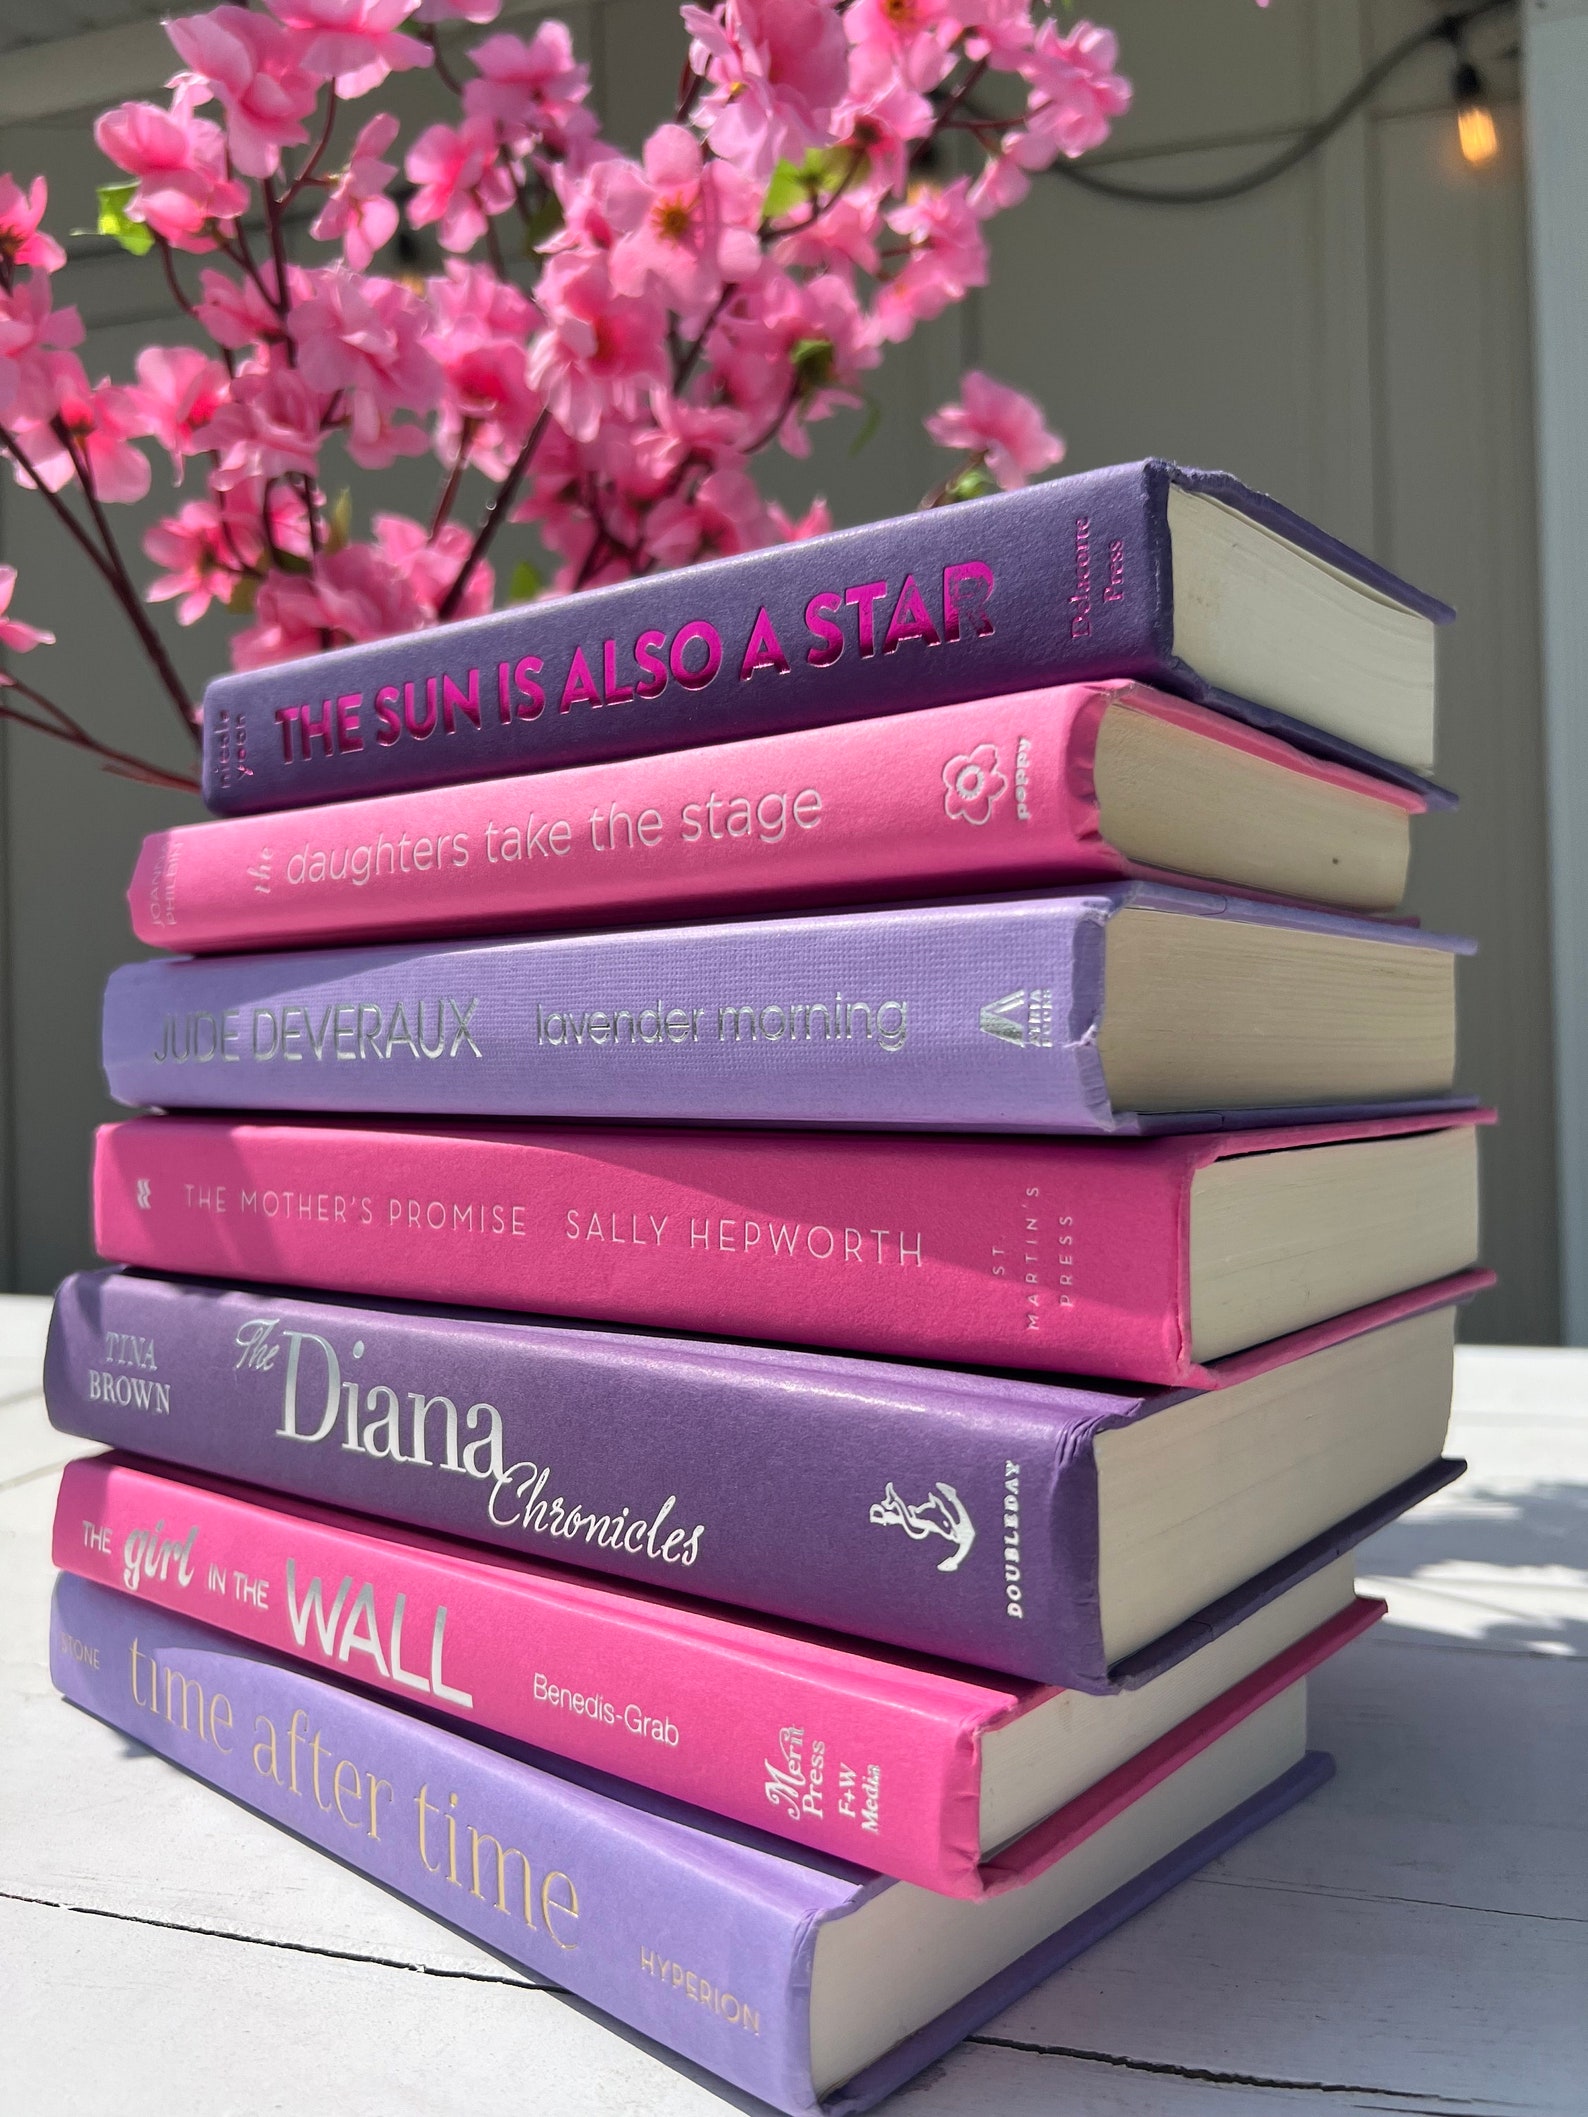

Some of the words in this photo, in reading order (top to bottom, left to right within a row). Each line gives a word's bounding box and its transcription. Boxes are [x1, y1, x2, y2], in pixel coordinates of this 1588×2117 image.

[1069, 516, 1091, 639] Delacorte
[1102, 539, 1124, 603] Press
[274, 692, 364, 764] THE
[375, 669, 481, 747] SUN
[498, 656, 545, 724] IS
[559, 619, 722, 715] ALSO
[740, 606, 791, 681] A
[804, 561, 995, 667] STAR
[235, 713, 254, 781] yoon
[1014, 736, 1031, 821] poppy
[247, 847, 273, 894] the
[286, 830, 470, 886] daughters
[484, 813, 571, 864] take
[590, 801, 663, 851] the
[681, 787, 823, 844] stage
[153, 1008, 240, 1064] JUDE
[252, 996, 483, 1061] DEVERAUX
[536, 1000, 705, 1045] lavender
[719, 991, 908, 1052] morning
[184, 1183, 226, 1214] THE
[241, 1189, 373, 1224] MOTHER'S
[389, 1198, 526, 1236] PROMISE
[566, 1209, 668, 1246] SALLY
[690, 1217, 922, 1267] HEPWORTH
[1021, 1186, 1040, 1331] MARTIN'S
[1058, 1215, 1075, 1308] PRESS
[88, 1369, 171, 1416] BROWN
[104, 1331, 158, 1371] TINA
[234, 1318, 280, 1372] The
[275, 1330, 506, 1481] Diana
[487, 1460, 705, 1567] Chronicles
[1003, 1459, 1023, 1620] DOUBLEDAY
[82, 1519, 113, 1555] THE
[123, 1519, 199, 1591] girl
[208, 1563, 226, 1597] IN
[233, 1570, 270, 1611] THE
[286, 1557, 474, 1709] WALL
[533, 1672, 680, 1747] Benedis-Grab
[129, 1635, 234, 1755] time
[252, 1708, 393, 1842] after
[414, 1783, 580, 1950] time
[764, 1723, 806, 1821] Merit
[802, 1740, 825, 1819] Press
[838, 1761, 857, 1818] F+W
[861, 1764, 880, 1835] Media
[639, 1944, 761, 2037] HYPERION
